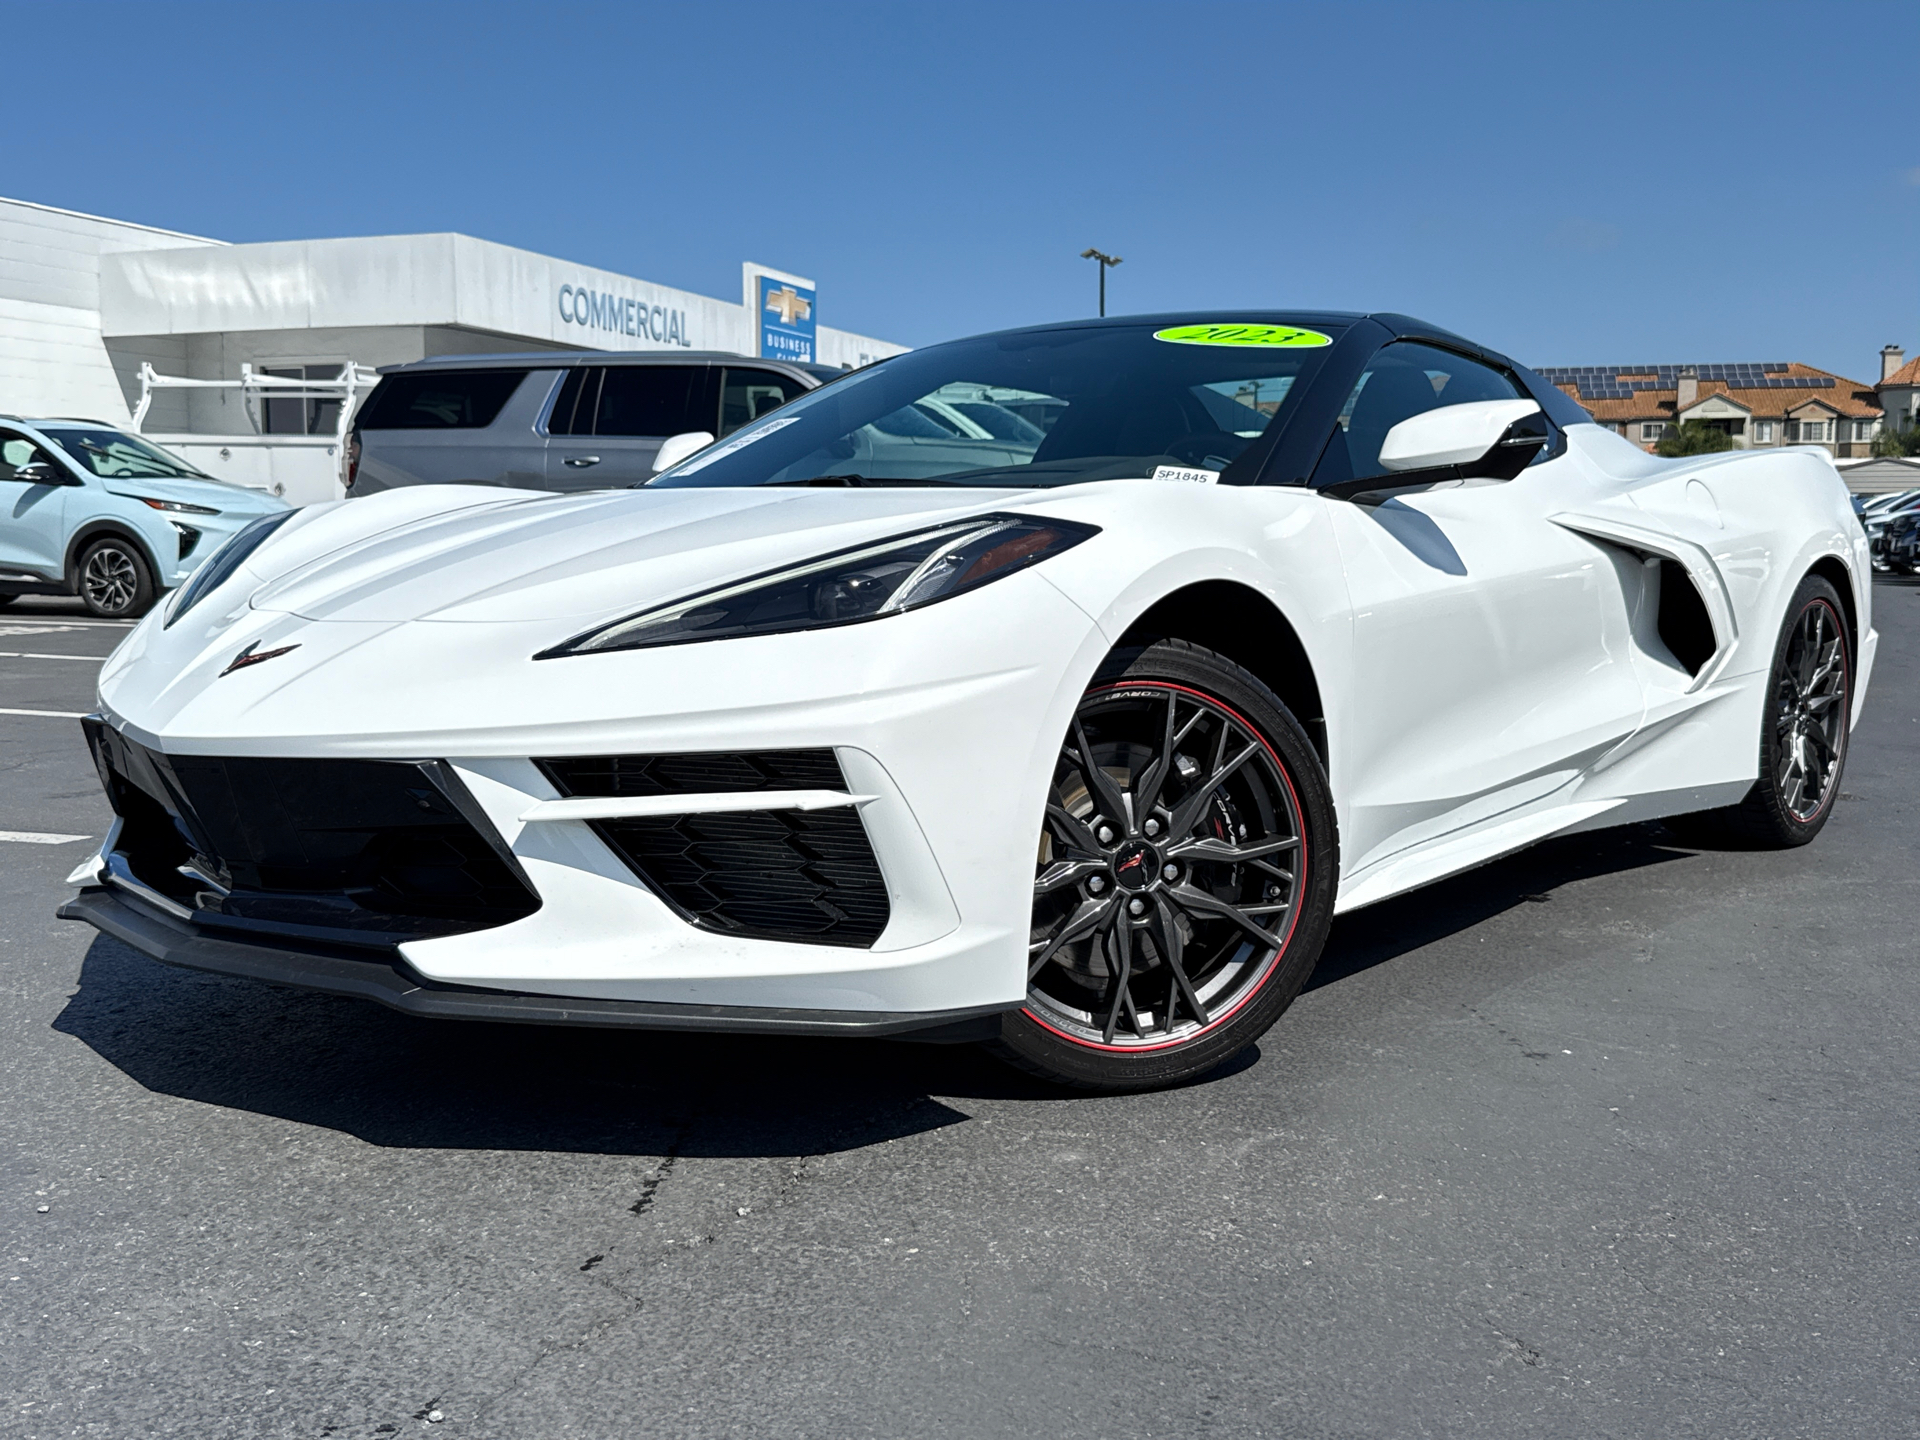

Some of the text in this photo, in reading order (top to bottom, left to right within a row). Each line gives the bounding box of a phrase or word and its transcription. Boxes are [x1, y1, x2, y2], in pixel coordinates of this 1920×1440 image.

[558, 283, 691, 348] COMMERCIAL
[767, 333, 811, 355] BUSINESS
[1176, 327, 1306, 343] 2023
[1157, 469, 1208, 484] SP1845
